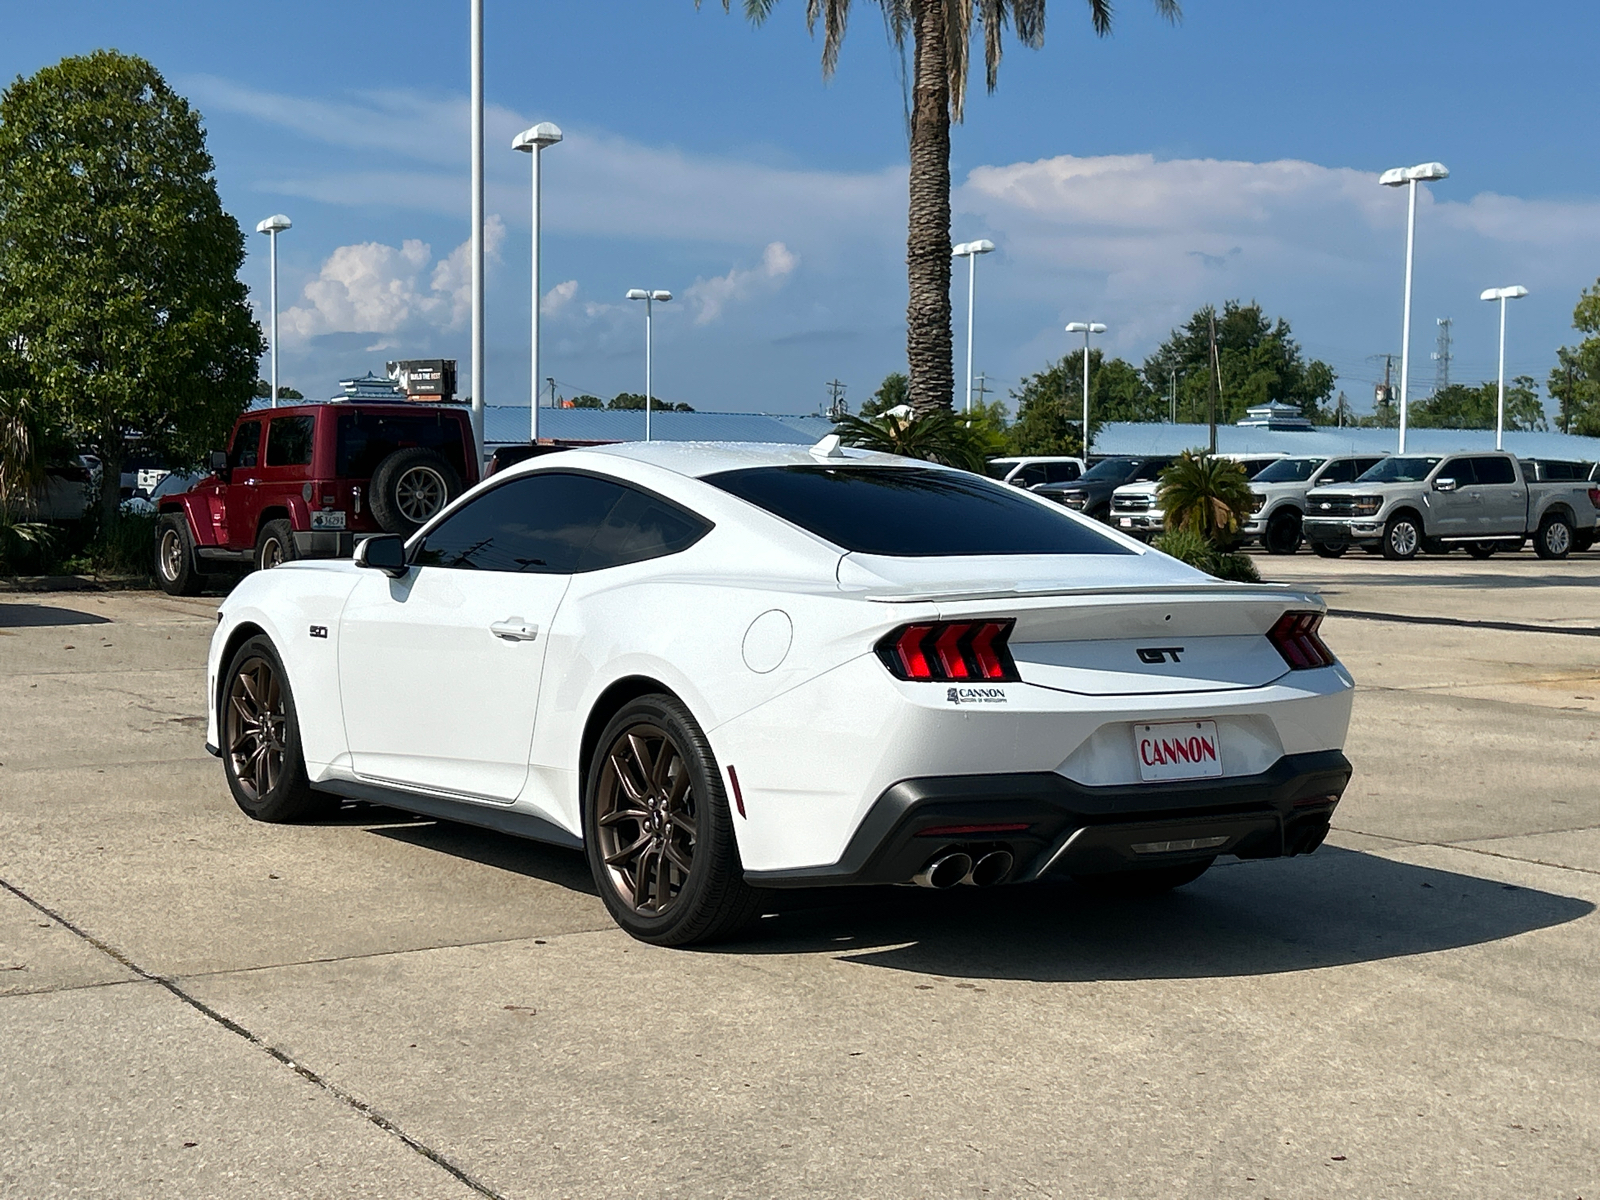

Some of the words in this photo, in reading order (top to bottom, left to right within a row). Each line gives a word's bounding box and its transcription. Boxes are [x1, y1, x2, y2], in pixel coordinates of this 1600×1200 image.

[1136, 647, 1184, 664] GT
[959, 688, 1006, 698] CANNON
[1140, 736, 1216, 766] CANNON
